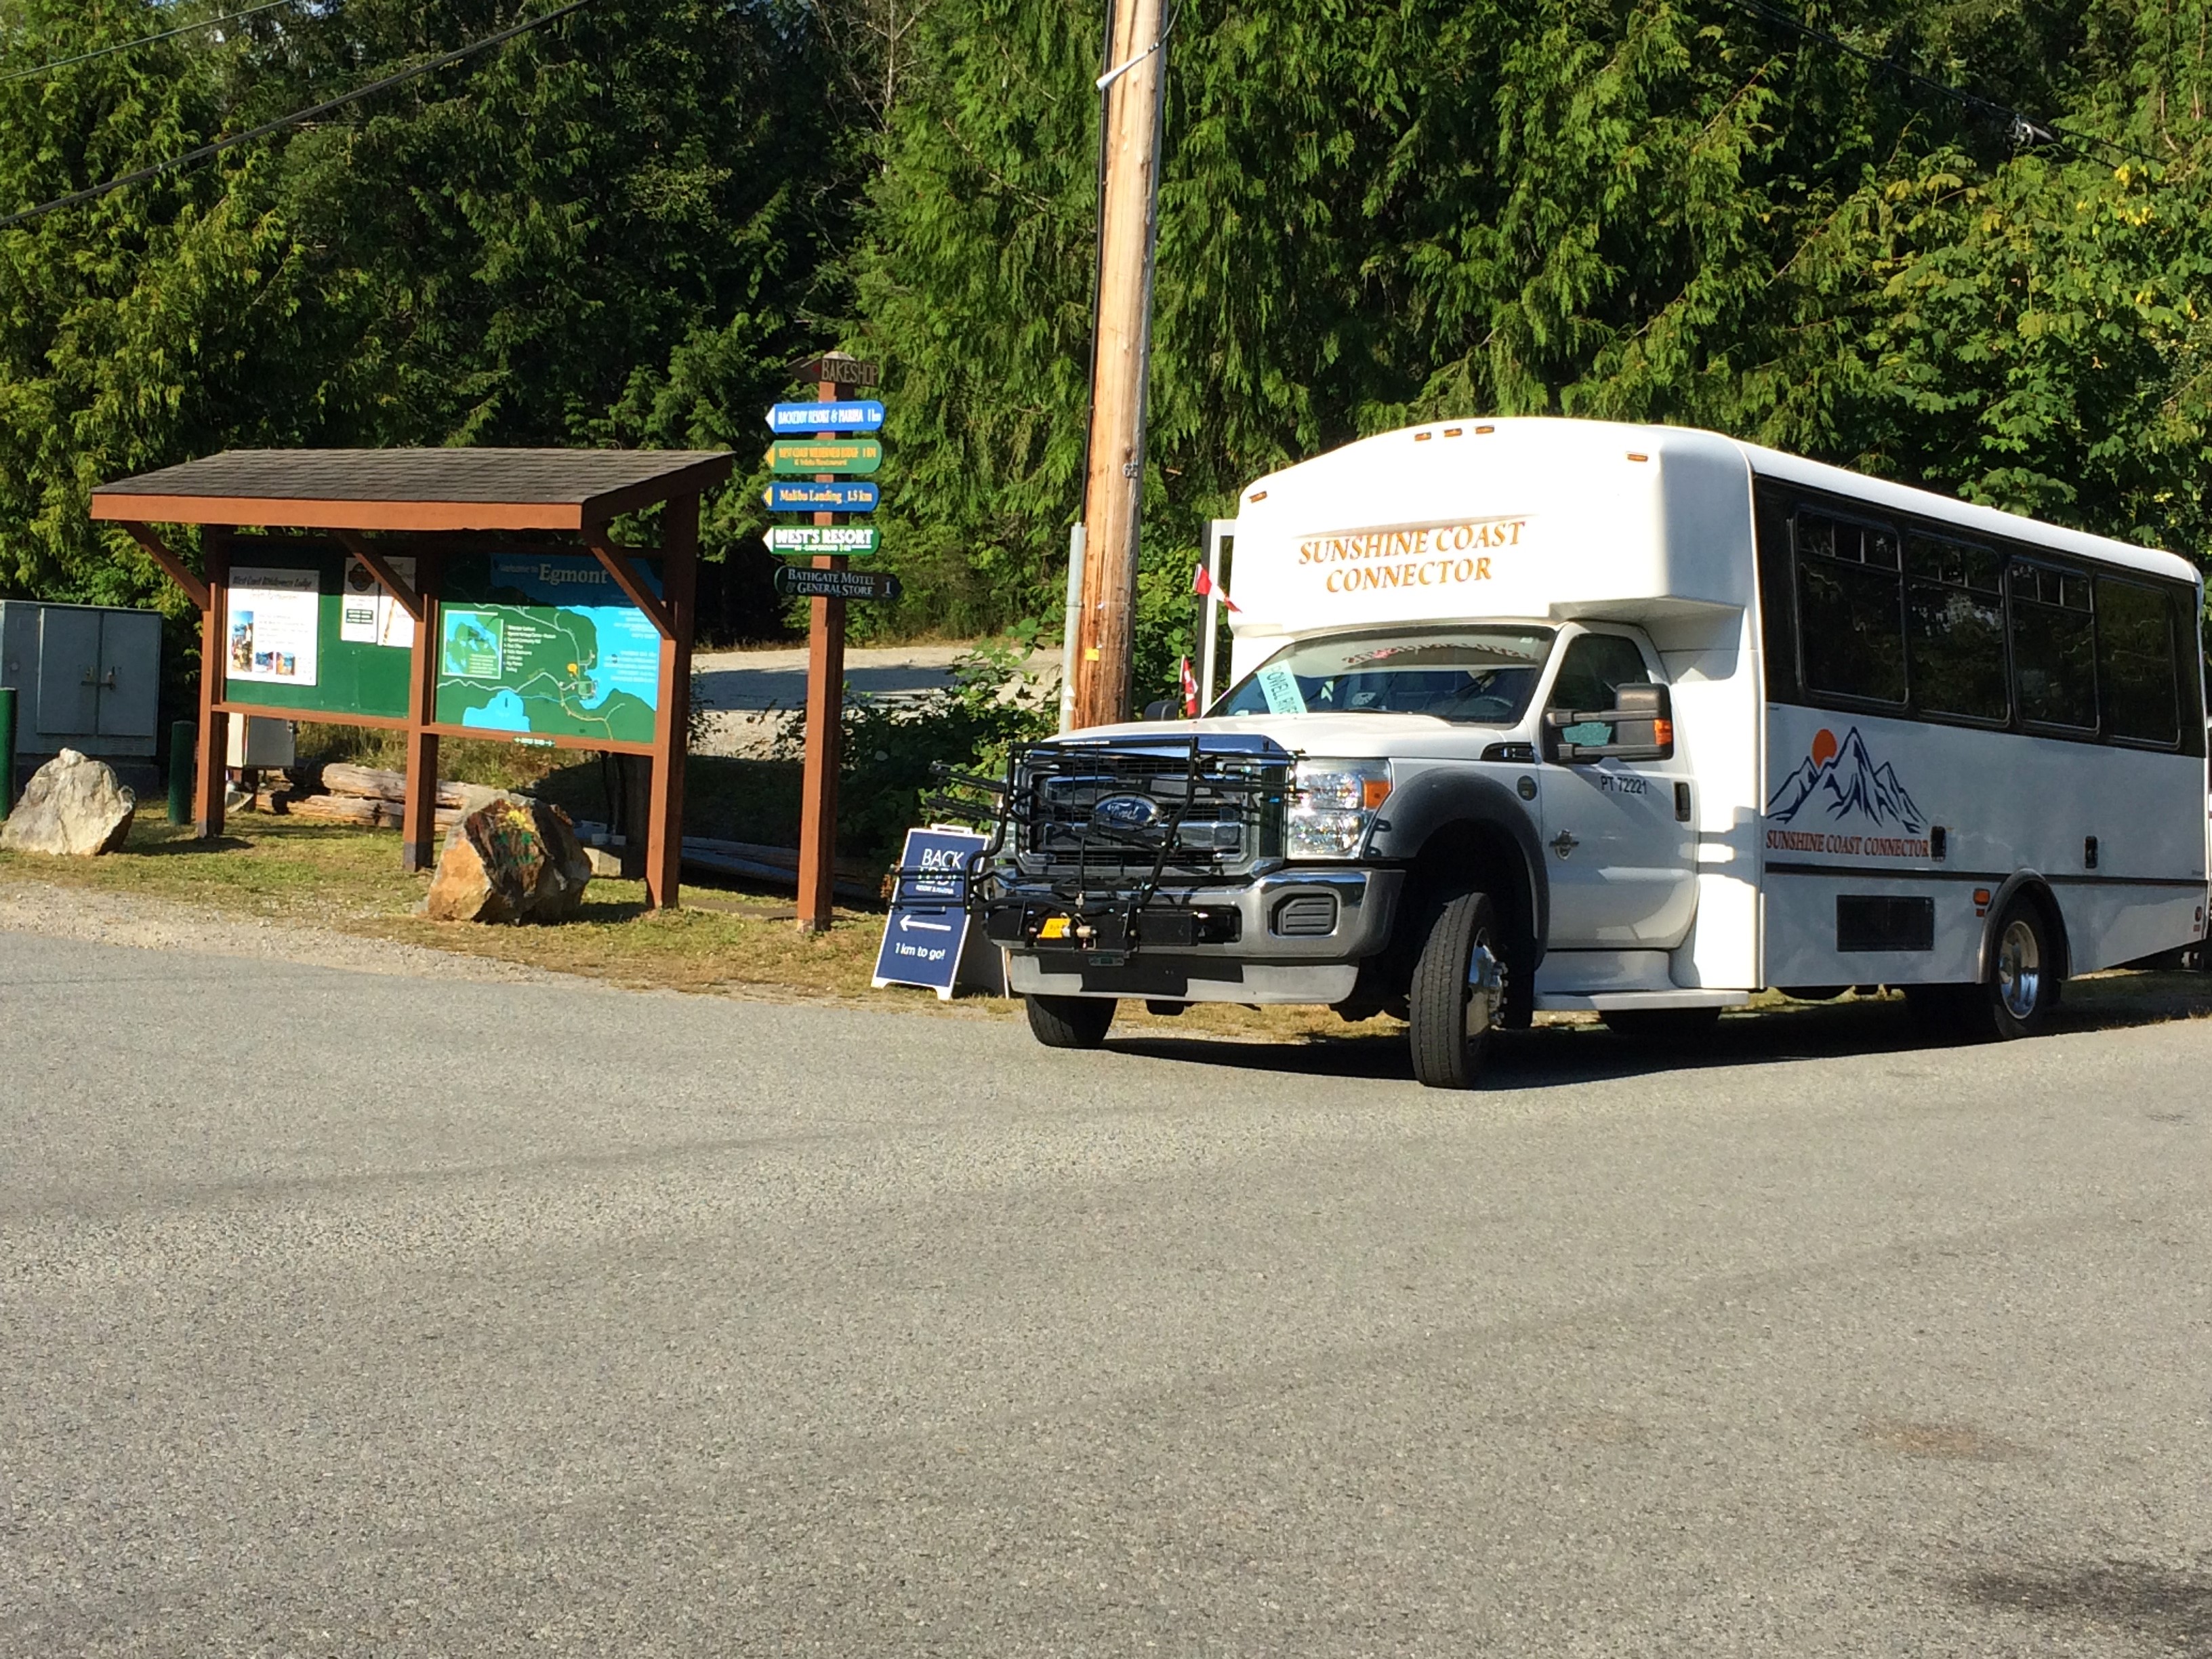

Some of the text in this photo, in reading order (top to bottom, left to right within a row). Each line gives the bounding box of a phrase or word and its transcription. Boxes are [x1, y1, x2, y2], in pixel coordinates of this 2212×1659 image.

[821, 359, 878, 385] BAKESHOP
[808, 410, 830, 423] RESORT
[831, 410, 838, 423] &
[838, 409, 863, 423] MARINA
[780, 489, 872, 504] Malibu Landing 1.5 km
[775, 529, 873, 544] WEST'S RESORT
[1298, 521, 1525, 565] SUNSHINE COAST
[539, 563, 609, 586] Egmont
[787, 569, 839, 583] BATHGATE
[840, 573, 876, 585] MOTEL
[1326, 557, 1492, 593] CONNECTOR
[797, 582, 841, 594] GENERAL
[842, 585, 873, 596] STORE
[1601, 775, 1647, 794] PT 72221
[1107, 802, 1140, 821] Ford
[1766, 830, 1929, 857] SUNSHINE COAST CONNECTOR
[922, 848, 964, 869] BACK
[895, 942, 946, 960] 1 km to go!
